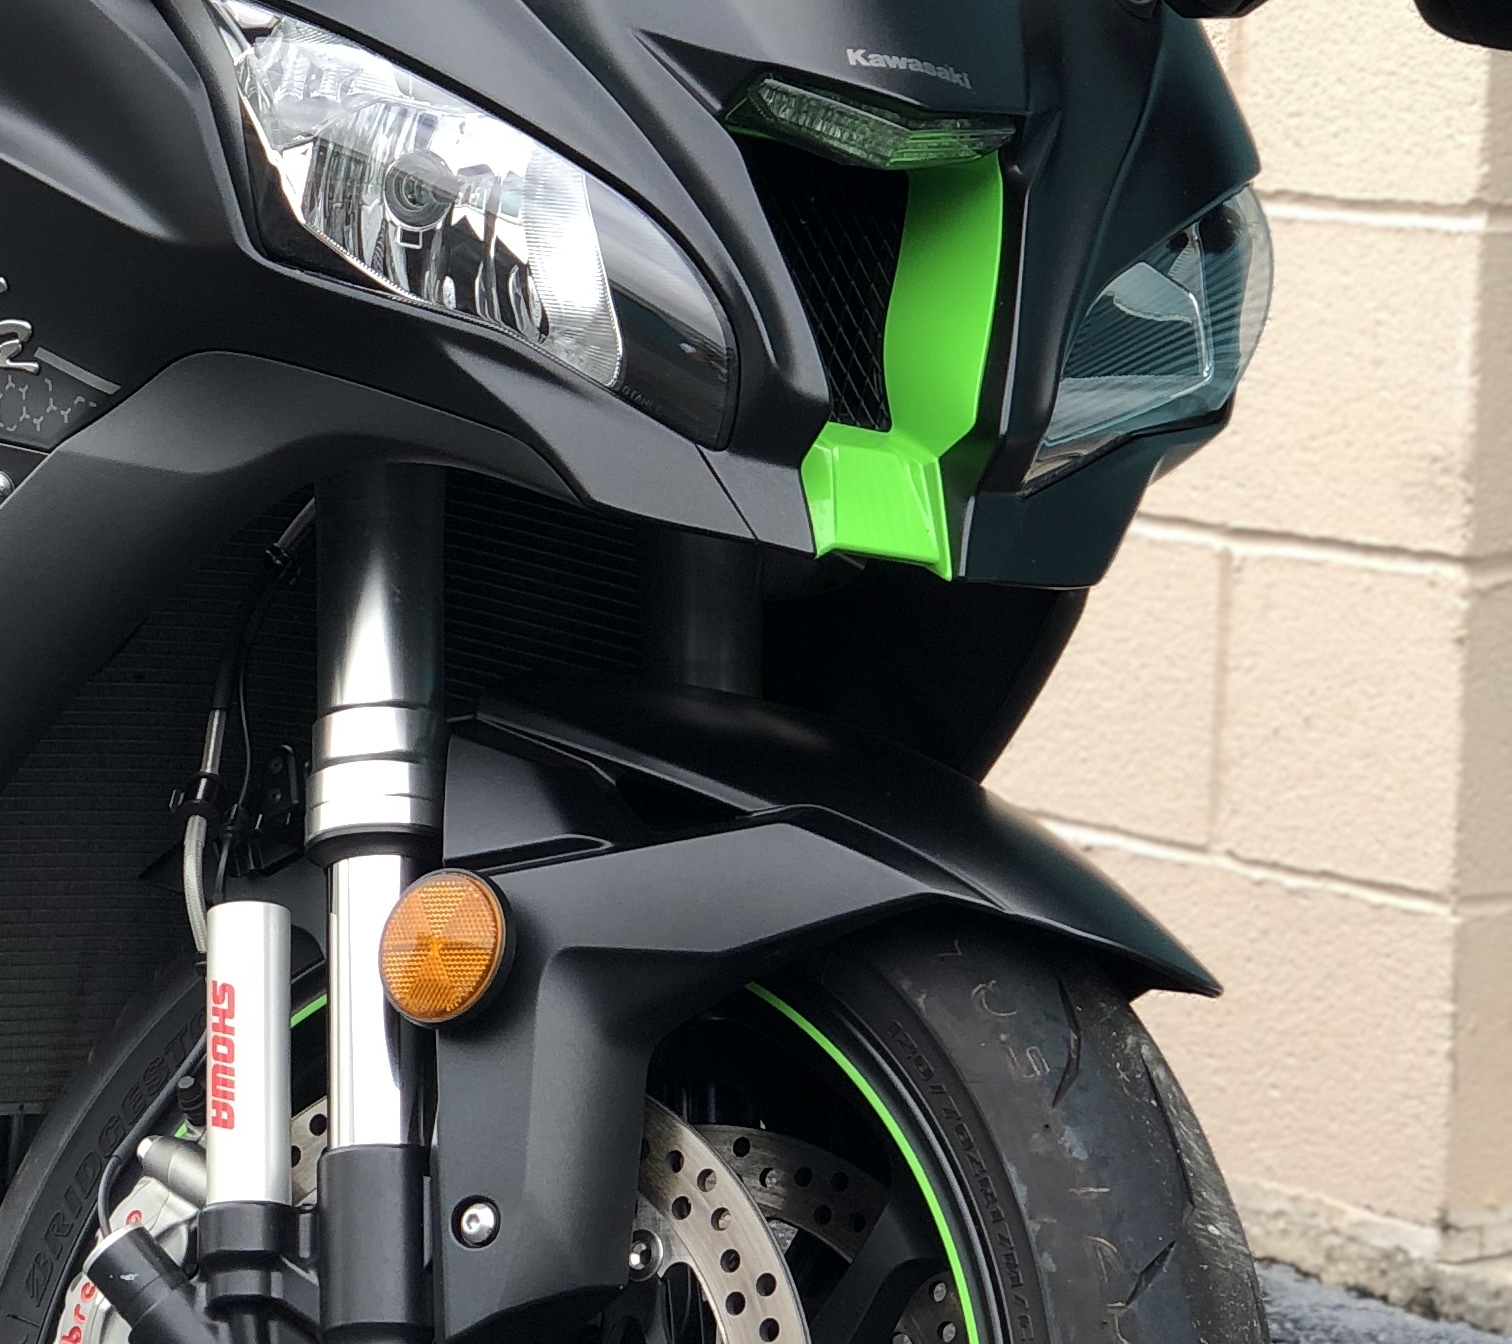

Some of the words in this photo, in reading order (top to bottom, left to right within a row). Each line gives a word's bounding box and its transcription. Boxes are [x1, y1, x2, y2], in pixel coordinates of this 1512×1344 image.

[845, 47, 972, 90] Kawasaki
[211, 980, 236, 1130] SHOWA
[25, 1013, 206, 1309] BRIDGESTO
